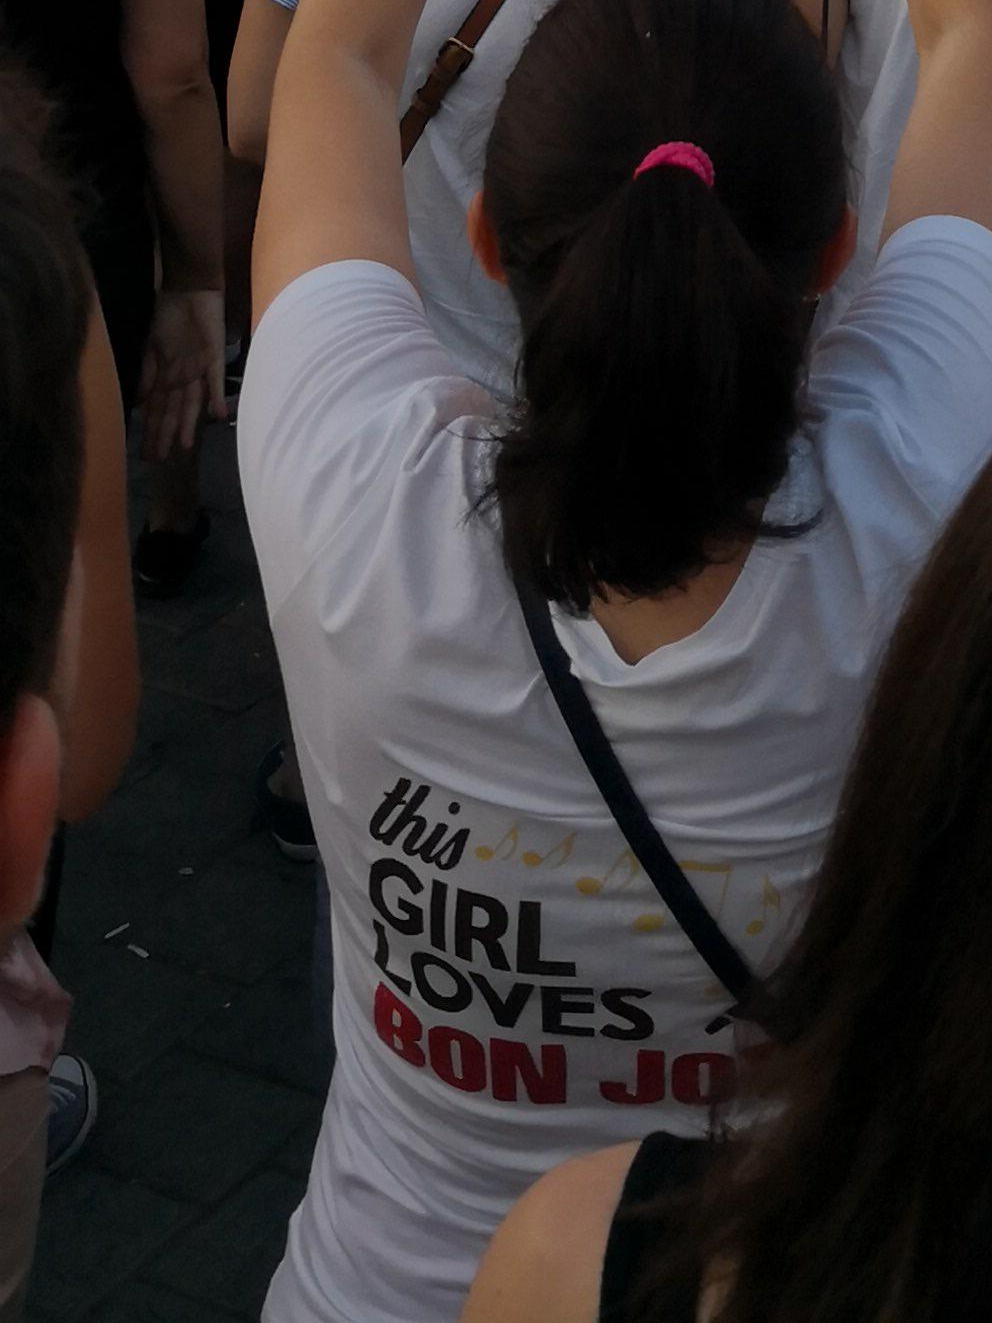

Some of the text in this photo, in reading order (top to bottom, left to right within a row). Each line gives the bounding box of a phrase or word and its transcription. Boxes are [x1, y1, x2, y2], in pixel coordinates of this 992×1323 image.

[369, 777, 471, 871] this
[369, 857, 577, 977] GIRL
[373, 919, 655, 1041] LOVES
[374, 981, 740, 1106] BON JO
